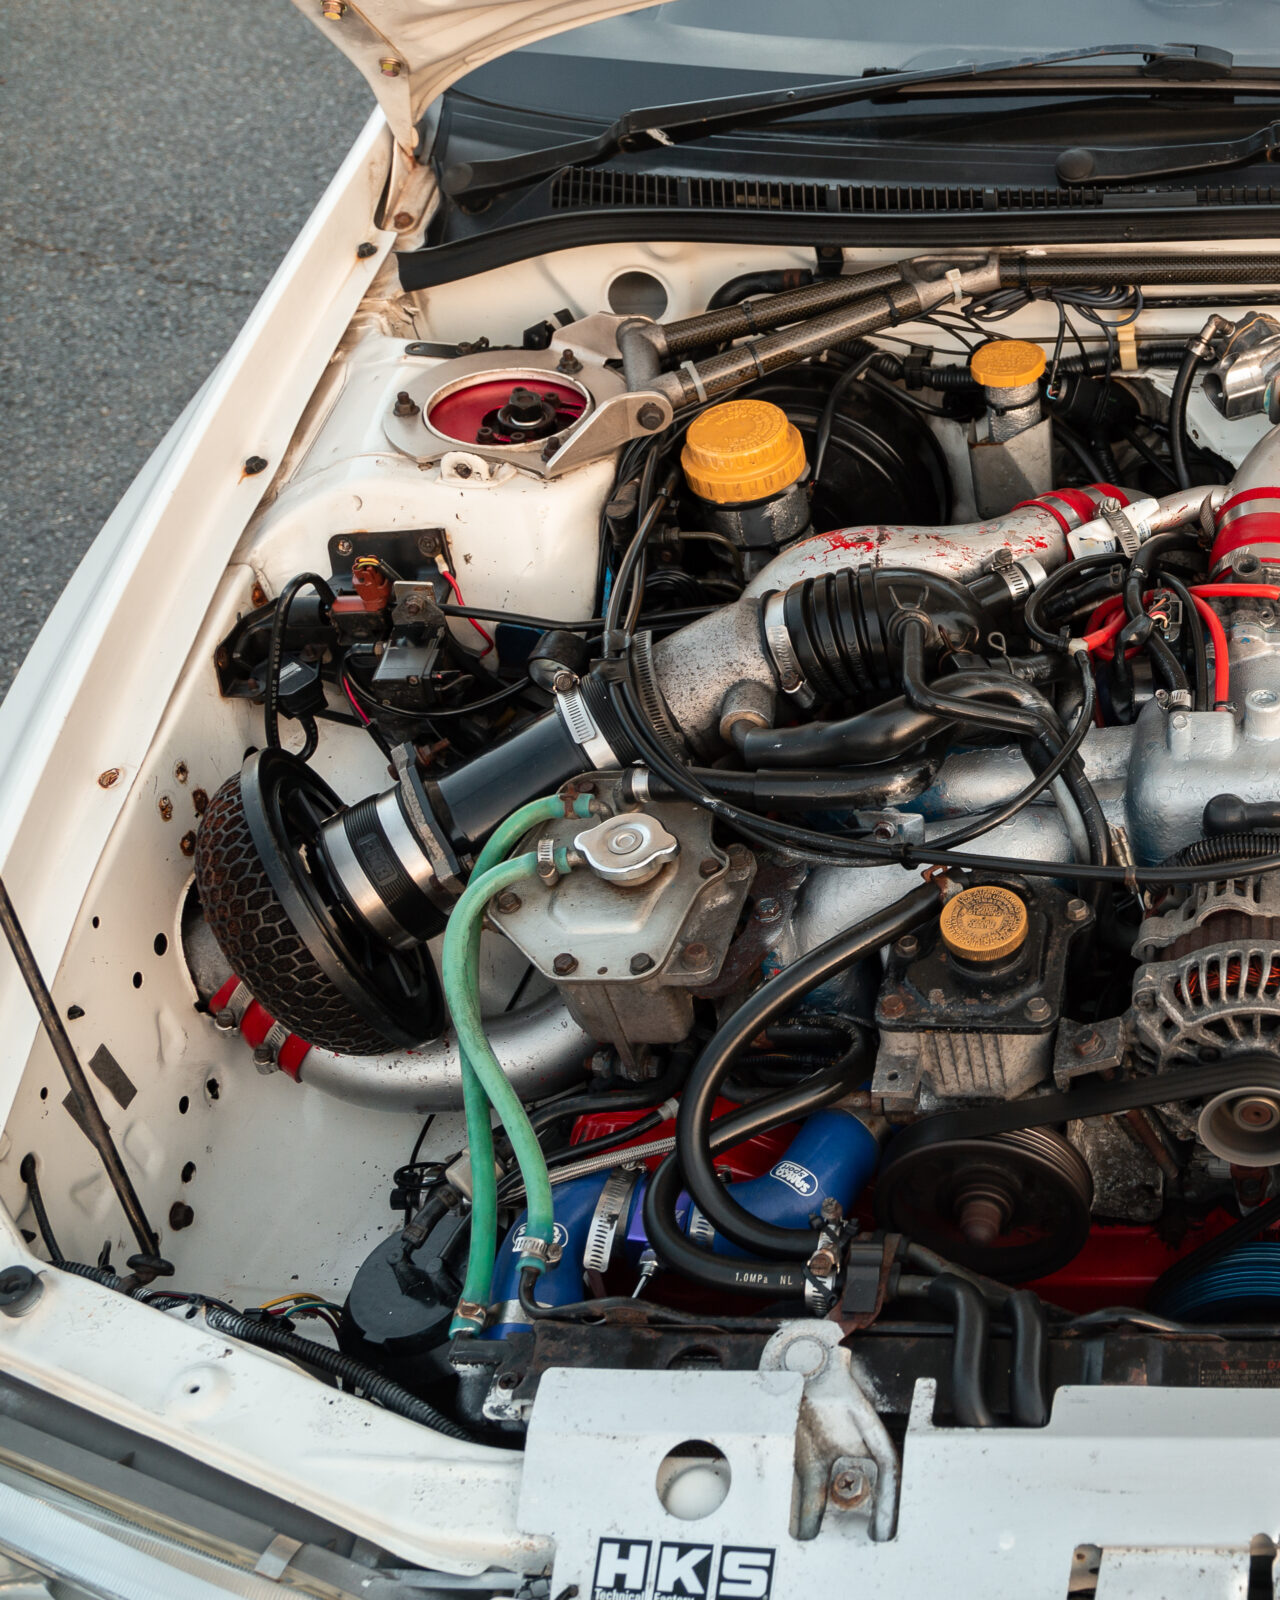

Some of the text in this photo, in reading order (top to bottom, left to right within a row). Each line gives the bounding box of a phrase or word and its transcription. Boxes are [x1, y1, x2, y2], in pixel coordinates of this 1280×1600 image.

[774, 1167, 811, 1194] SAMCO
[735, 1272, 793, 1286] 1.0MPa NL
[595, 1542, 772, 1598] HKS
